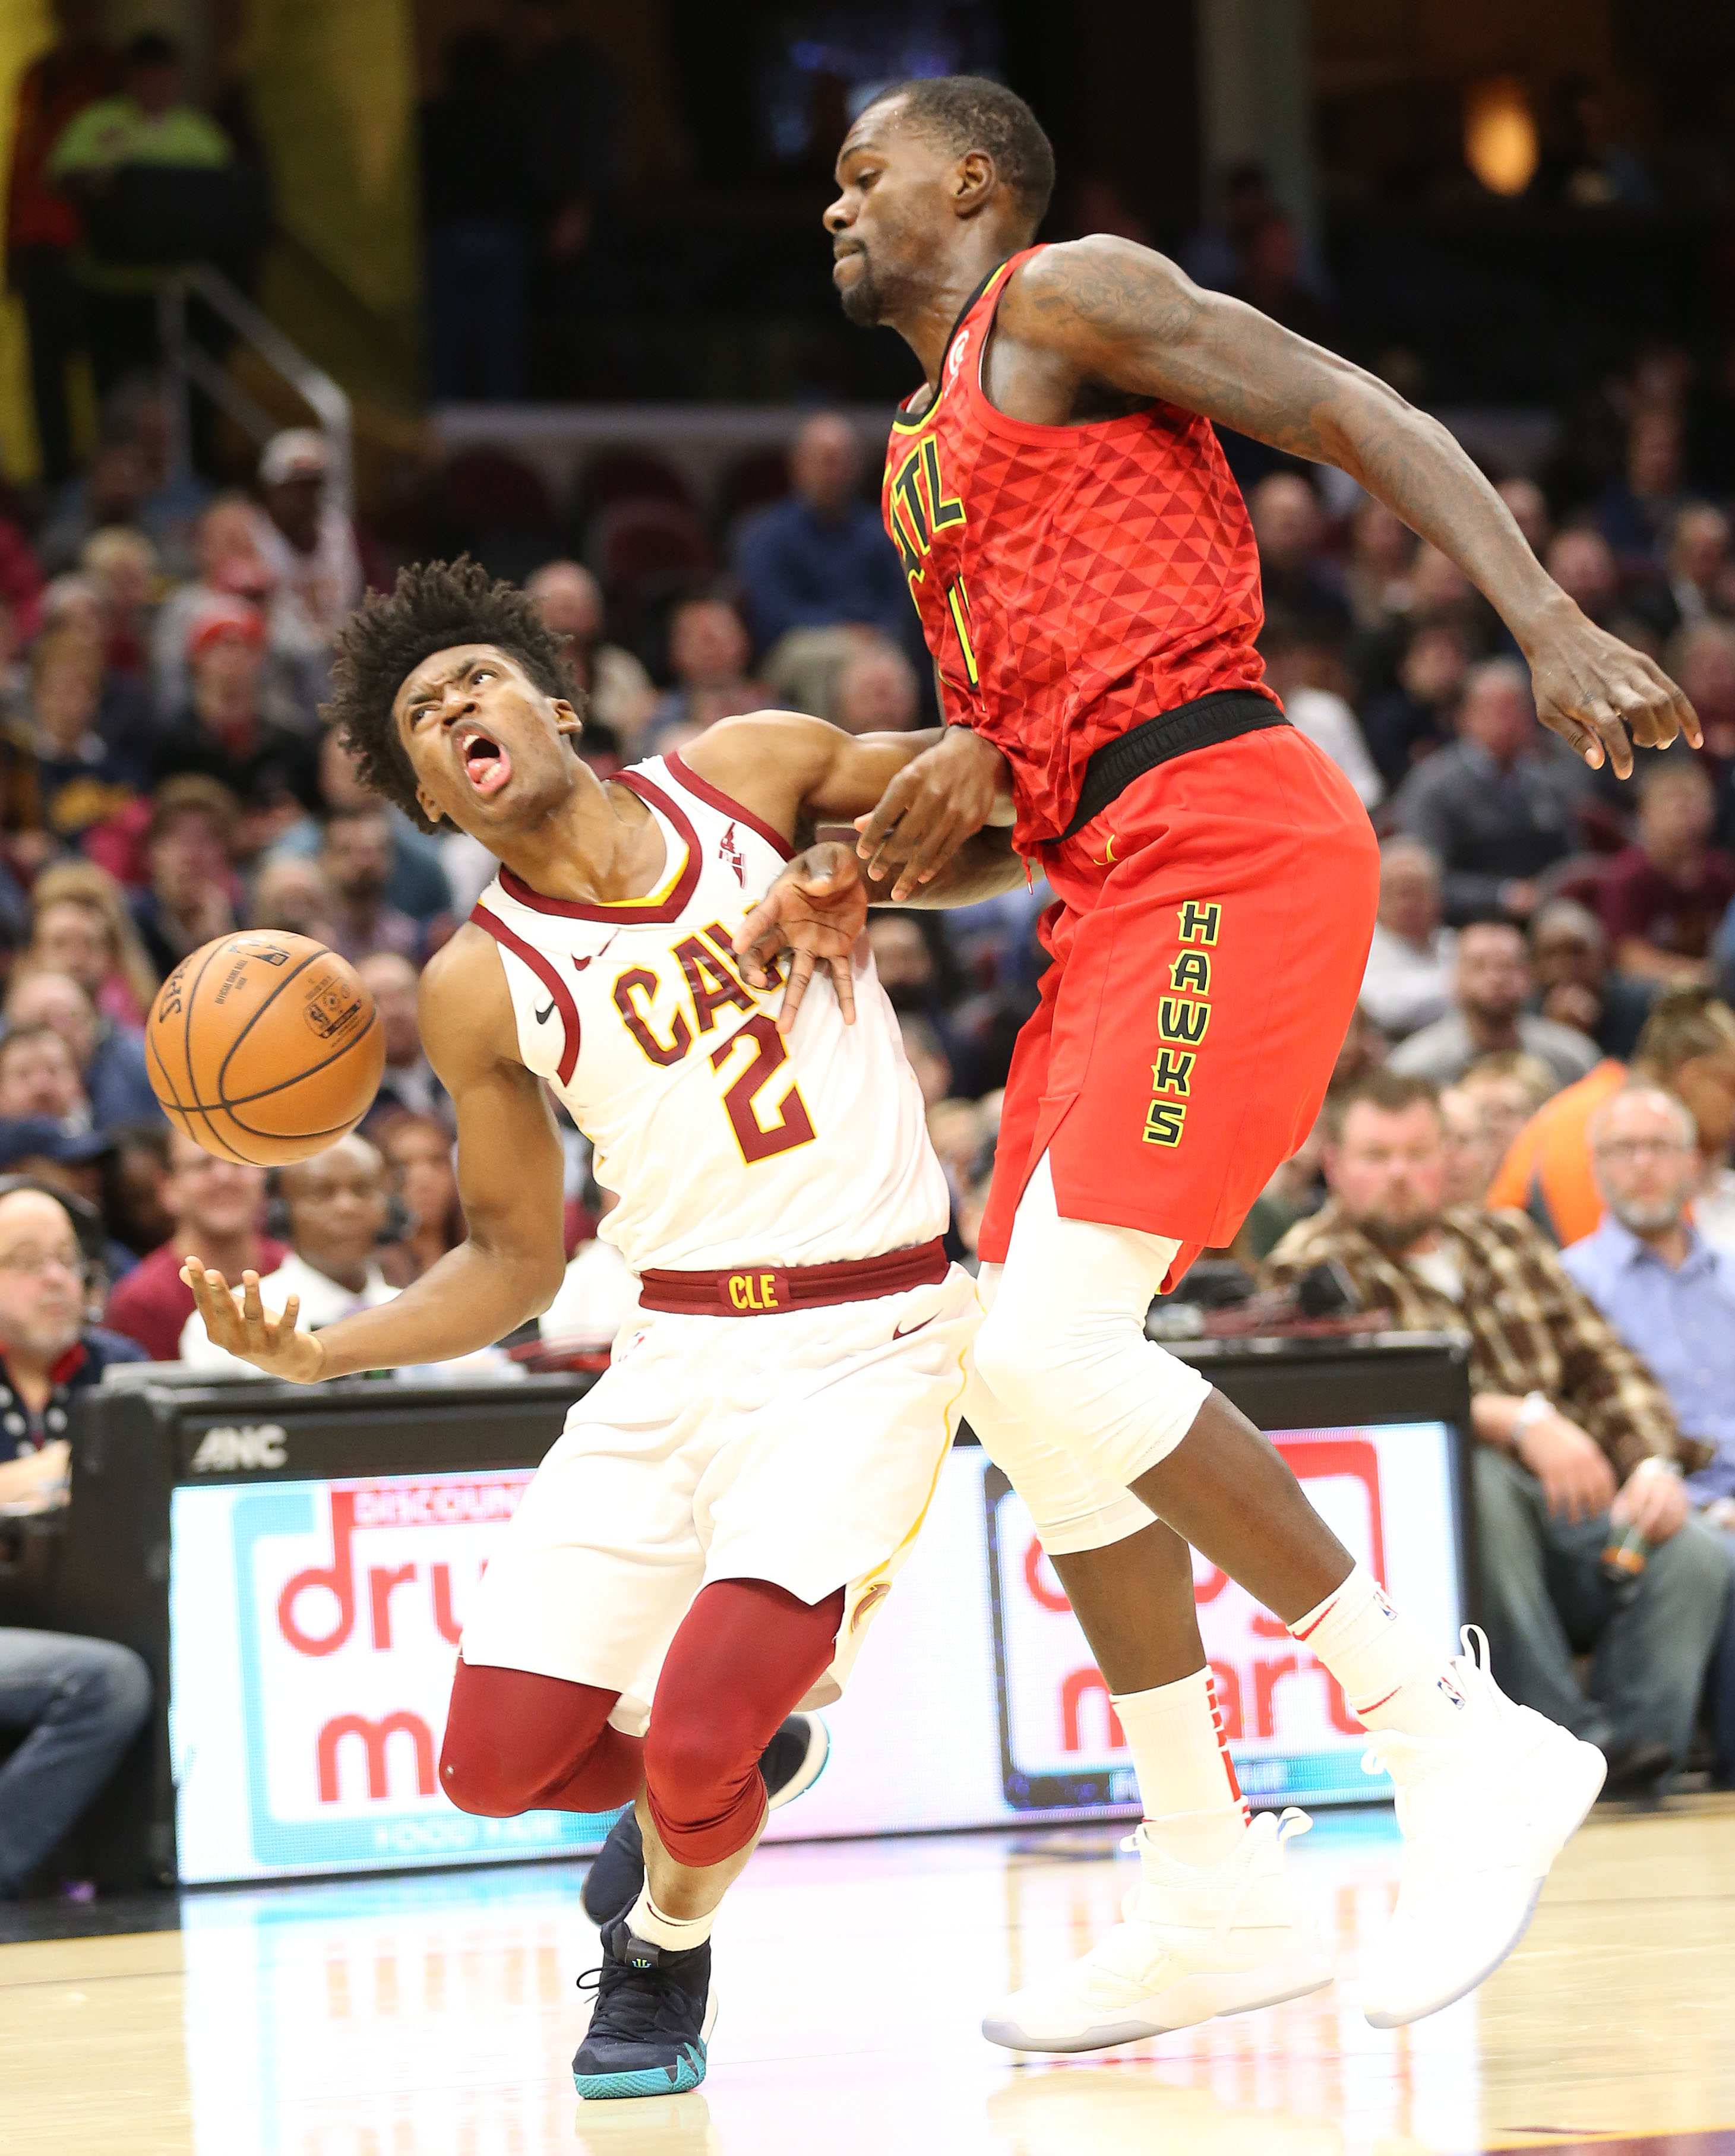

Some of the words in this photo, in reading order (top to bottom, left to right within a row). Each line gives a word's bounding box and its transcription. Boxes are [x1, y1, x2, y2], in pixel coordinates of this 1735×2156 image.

[1142, 900, 1222, 1148] HAWKS
[710, 1011, 817, 1166] 2
[728, 1275, 779, 1310] CLE
[191, 1424, 289, 1473] ANC
[355, 1485, 527, 1524] DISCOUN
[277, 1491, 489, 1658] dru
